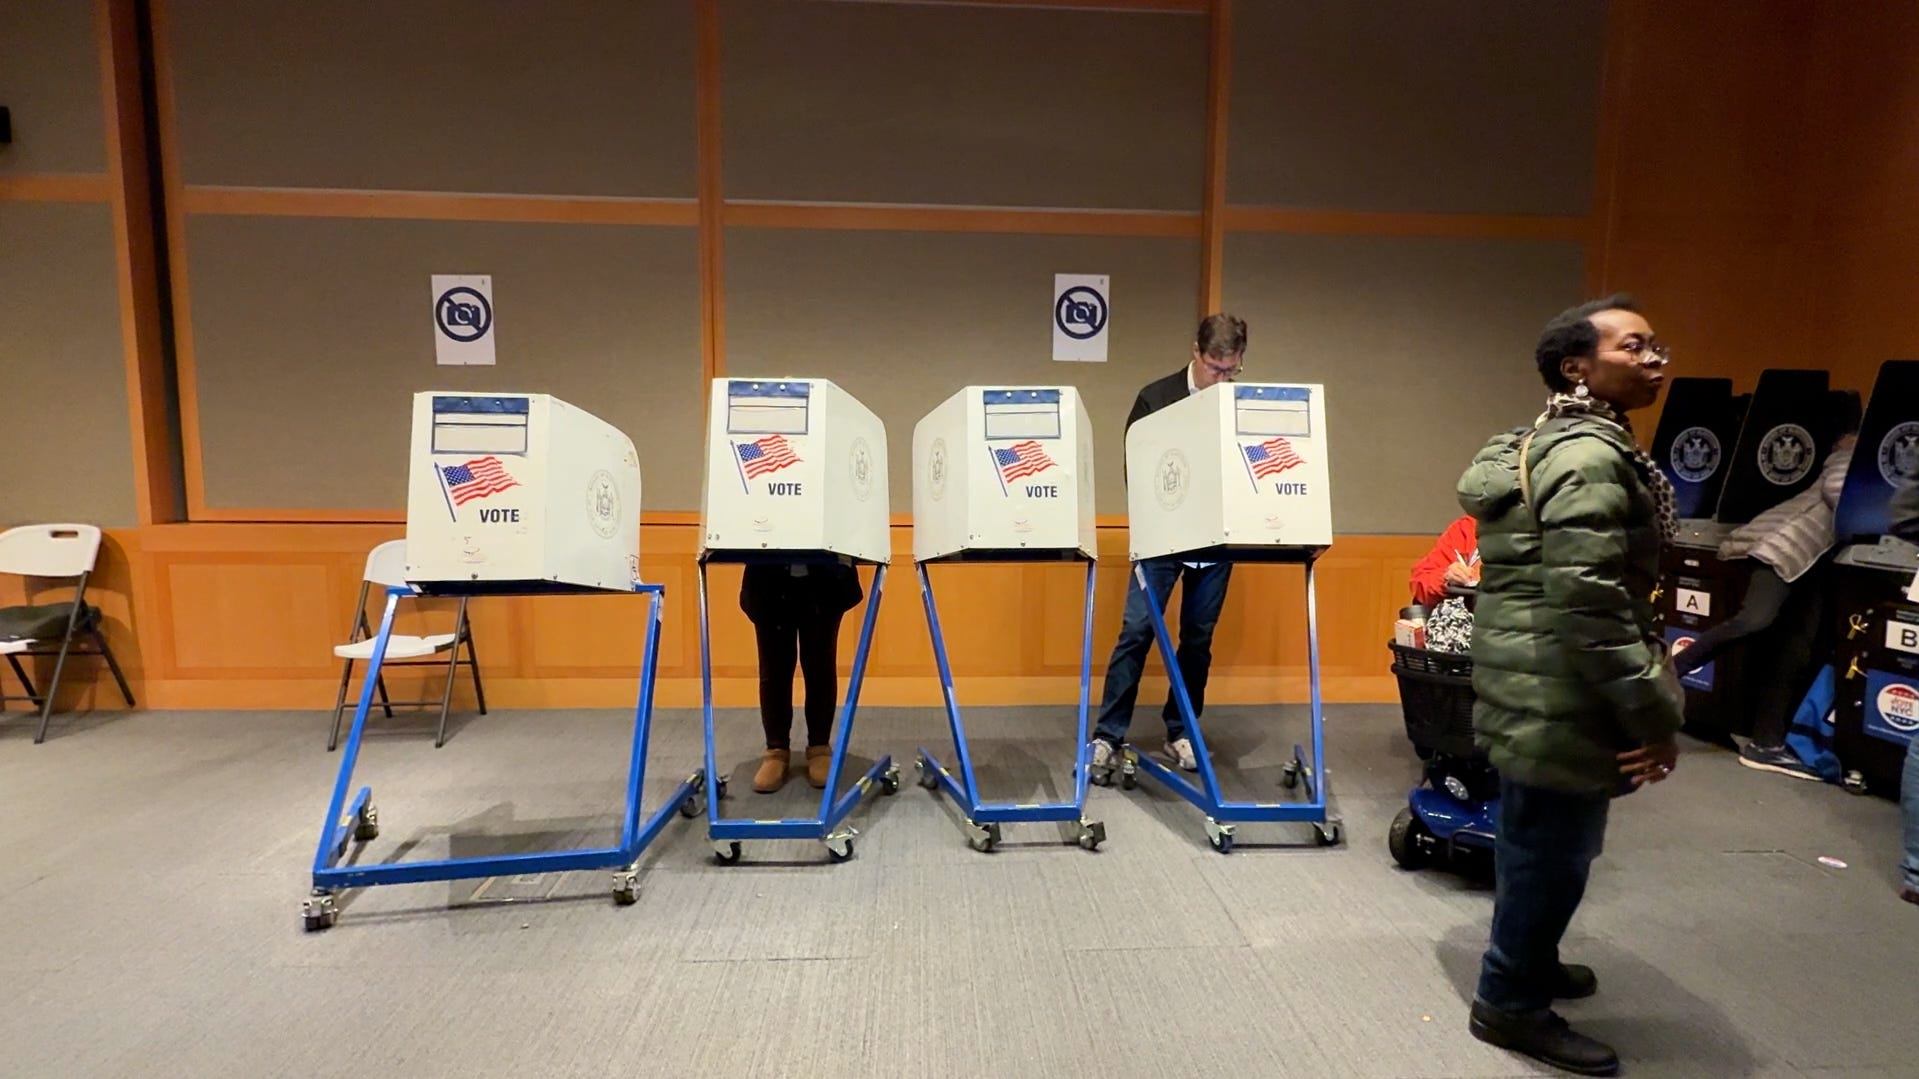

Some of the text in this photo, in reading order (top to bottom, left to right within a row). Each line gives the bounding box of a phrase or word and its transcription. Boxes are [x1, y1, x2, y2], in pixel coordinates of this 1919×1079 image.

[768, 482, 802, 496] VOTE
[1025, 485, 1058, 498] VOTE
[1275, 482, 1307, 496] VOTE
[480, 508, 520, 523] VOTE
[1686, 594, 1699, 610] A
[1901, 628, 1918, 648] B
[1890, 705, 1913, 717] NYC
